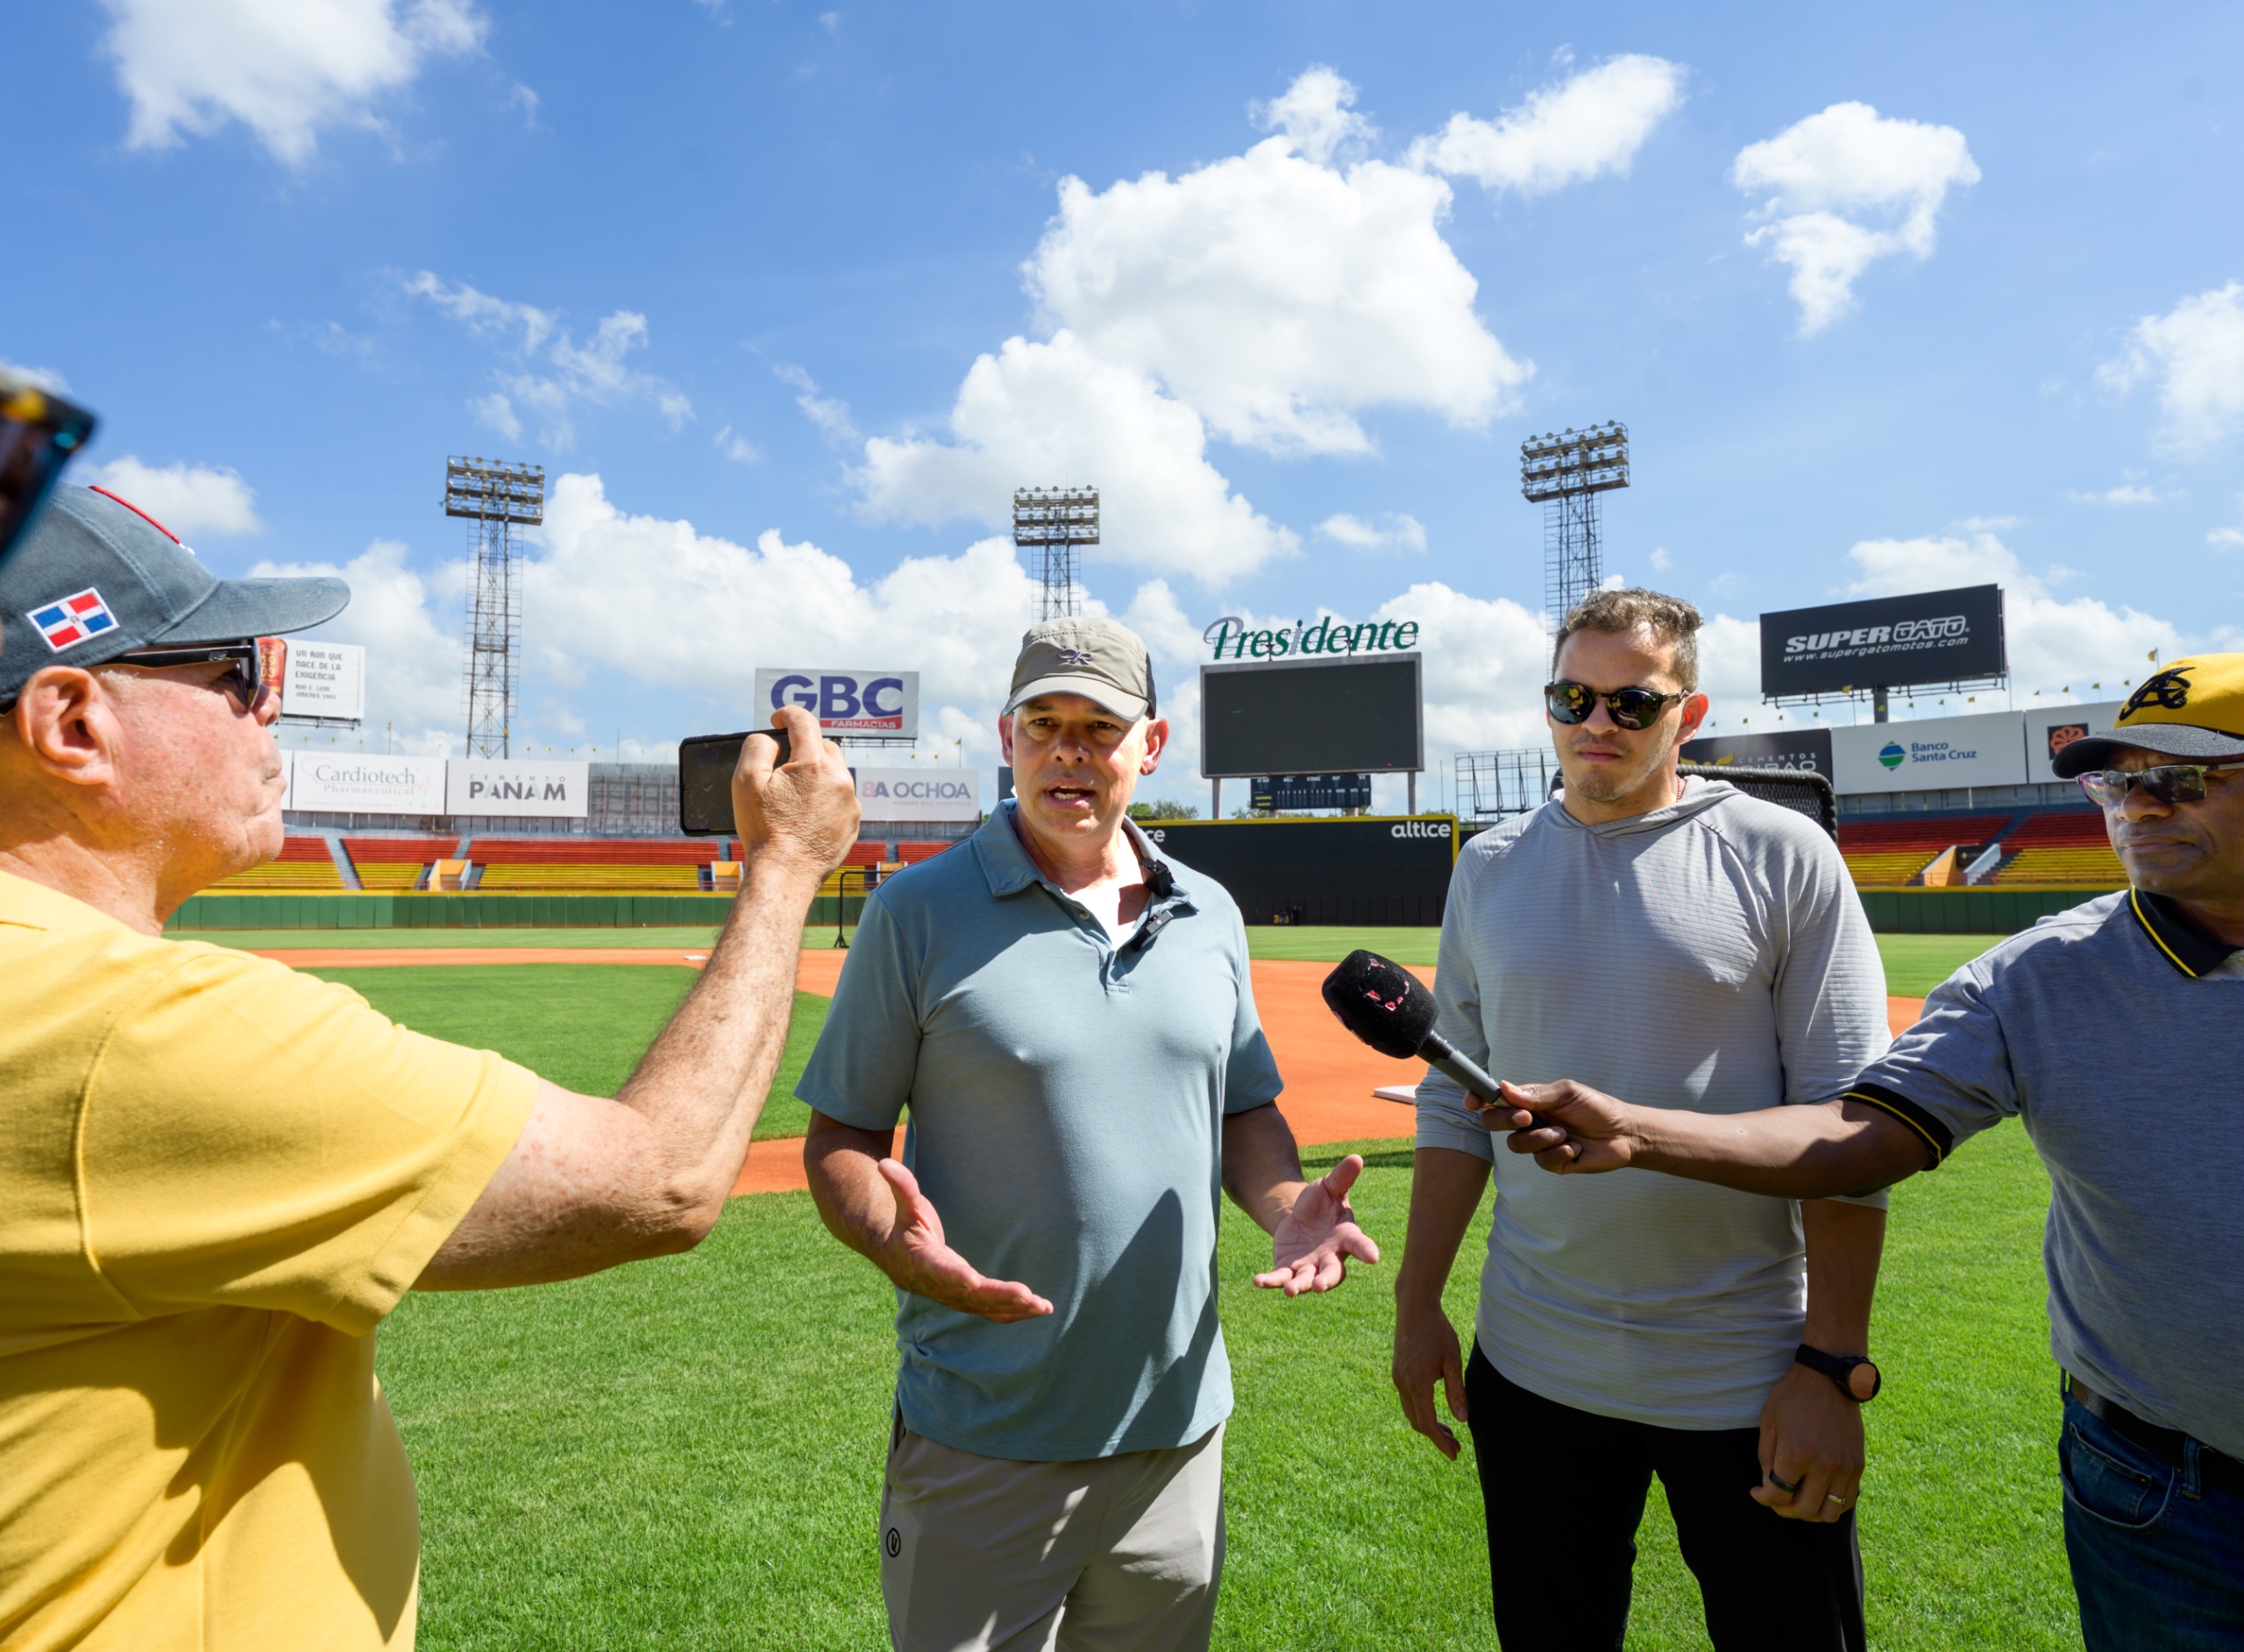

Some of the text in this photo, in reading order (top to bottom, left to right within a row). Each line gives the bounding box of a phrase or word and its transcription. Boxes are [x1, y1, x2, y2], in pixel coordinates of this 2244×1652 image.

[1203, 616, 1419, 660] Presidente
[1785, 626, 1892, 654] SUPER
[295, 649, 308, 658] UN
[328, 652, 344, 661] QUE
[1783, 636, 1969, 663] www.supergatomotos.com
[295, 660, 316, 670] NACE
[318, 662, 330, 670] DE
[295, 671, 336, 681] EXIGENCIA
[770, 675, 904, 719] GBC
[830, 720, 897, 729] FARMACIAS
[1911, 742, 1949, 753] Banco
[1738, 752, 1816, 764] CEMENTOS
[1912, 749, 1977, 763] Santa Cruz
[316, 764, 415, 784] Cardiotech
[470, 773, 565, 783] CEMENTO
[323, 783, 414, 796] Pharmaceutical
[469, 781, 566, 801] PANAM
[893, 781, 971, 799] OCHOA
[1391, 820, 1452, 838] altice
